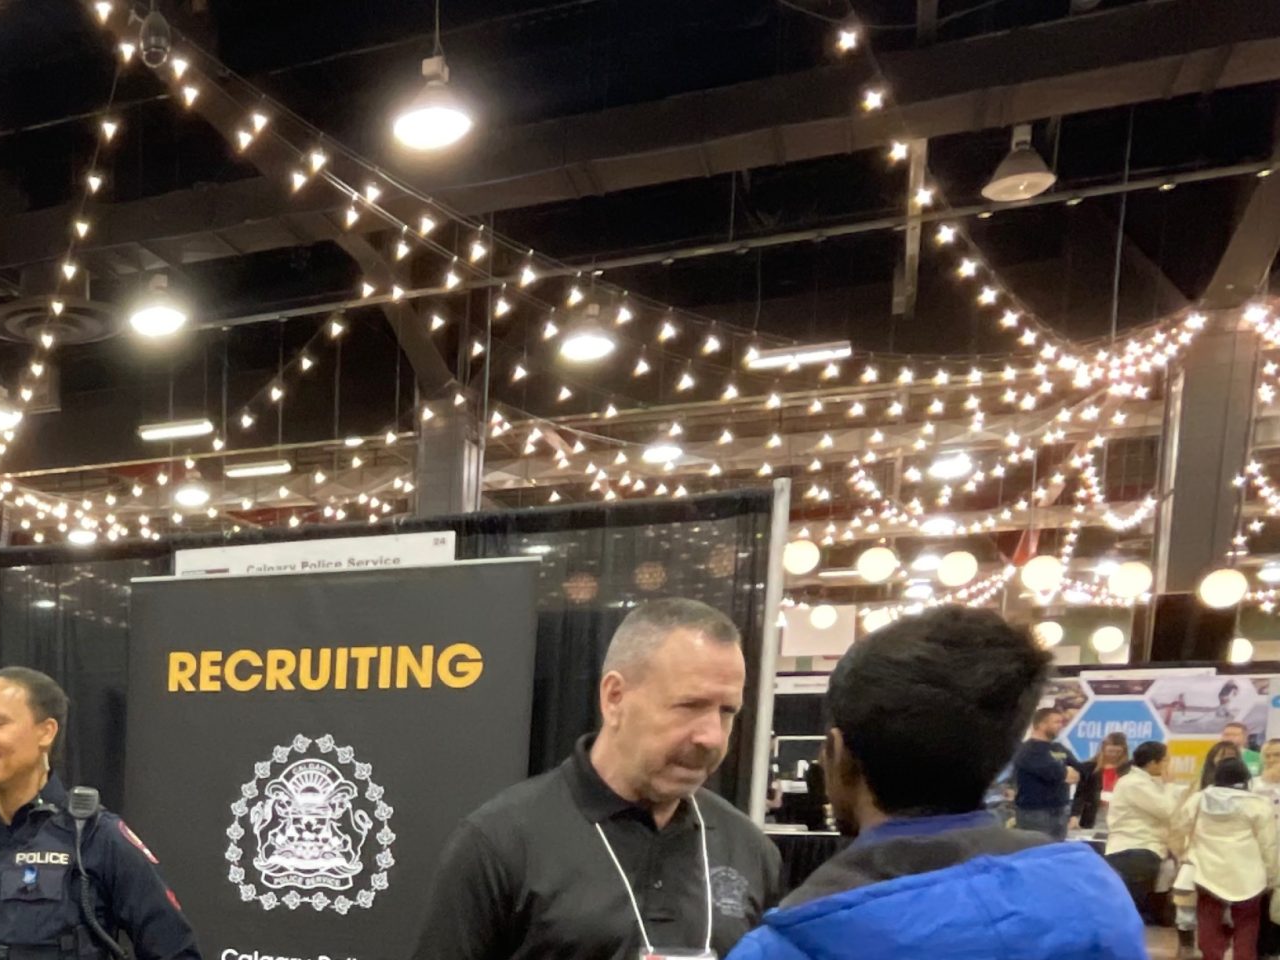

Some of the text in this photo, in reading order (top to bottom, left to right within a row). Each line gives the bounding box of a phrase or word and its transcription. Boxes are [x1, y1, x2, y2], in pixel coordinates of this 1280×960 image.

[347, 555, 401, 567] Service
[167, 642, 484, 693] RECRUITING
[15, 852, 69, 865] POLICE
